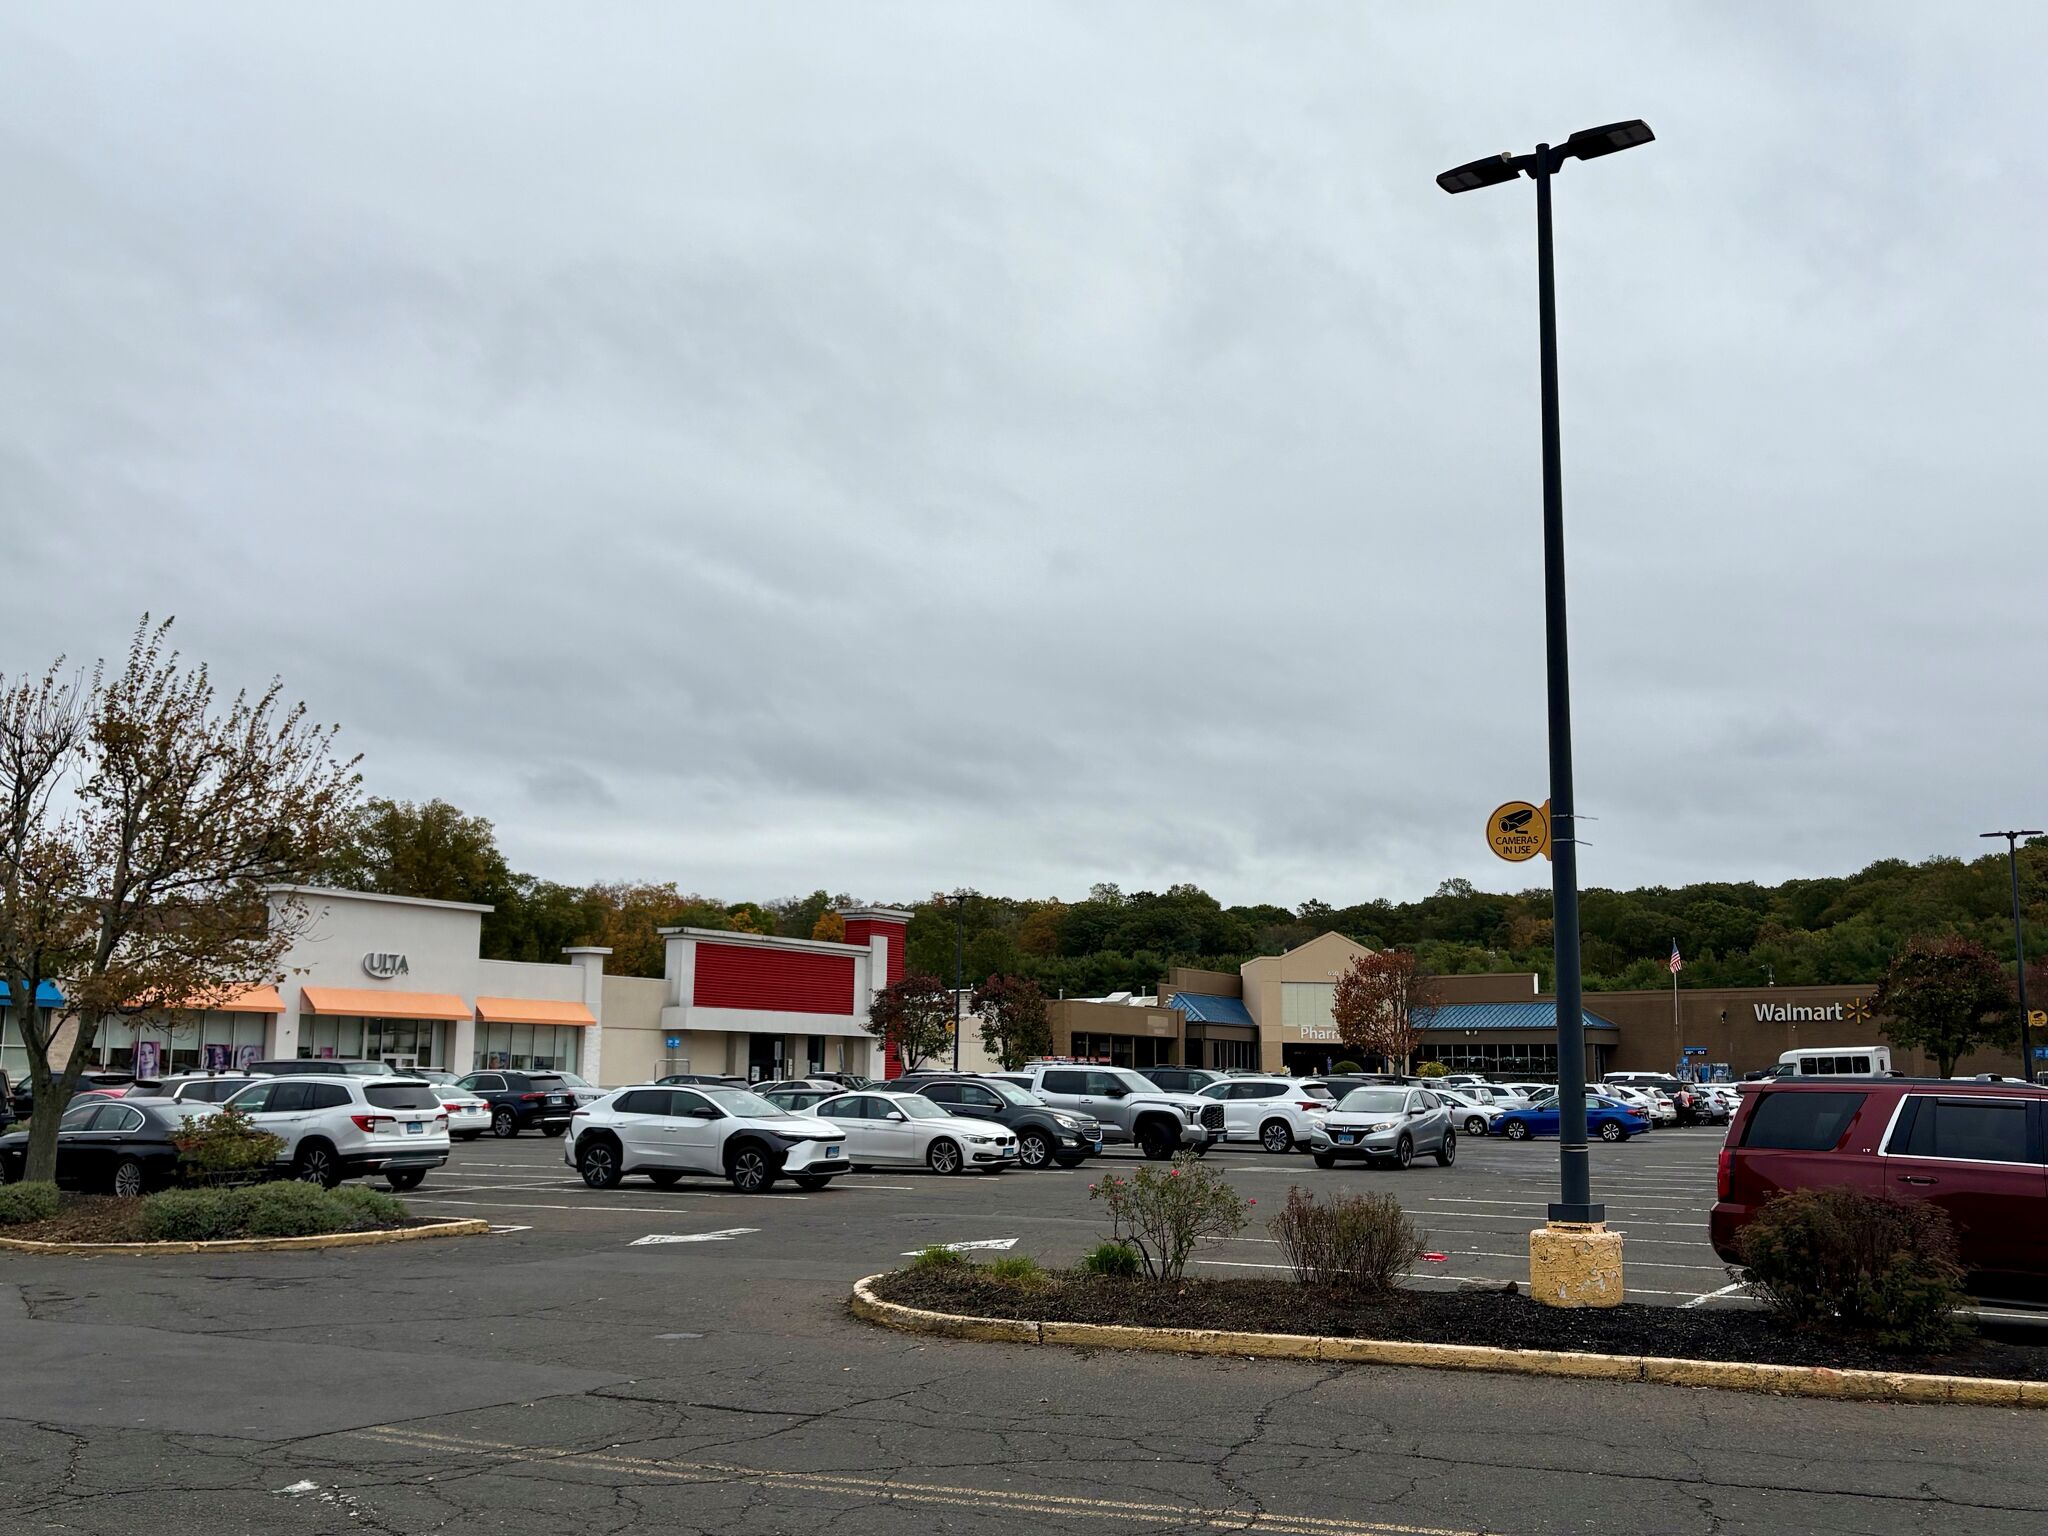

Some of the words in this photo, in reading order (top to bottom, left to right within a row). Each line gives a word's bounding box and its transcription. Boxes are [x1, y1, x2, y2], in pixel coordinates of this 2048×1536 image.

[1495, 835, 1539, 845] CAMERAS
[1503, 846, 1513, 855] IN
[1514, 846, 1532, 855] USE
[368, 952, 410, 974] ULTA
[1753, 1002, 1844, 1022] Walmart
[1300, 1026, 1341, 1040] Pharm
